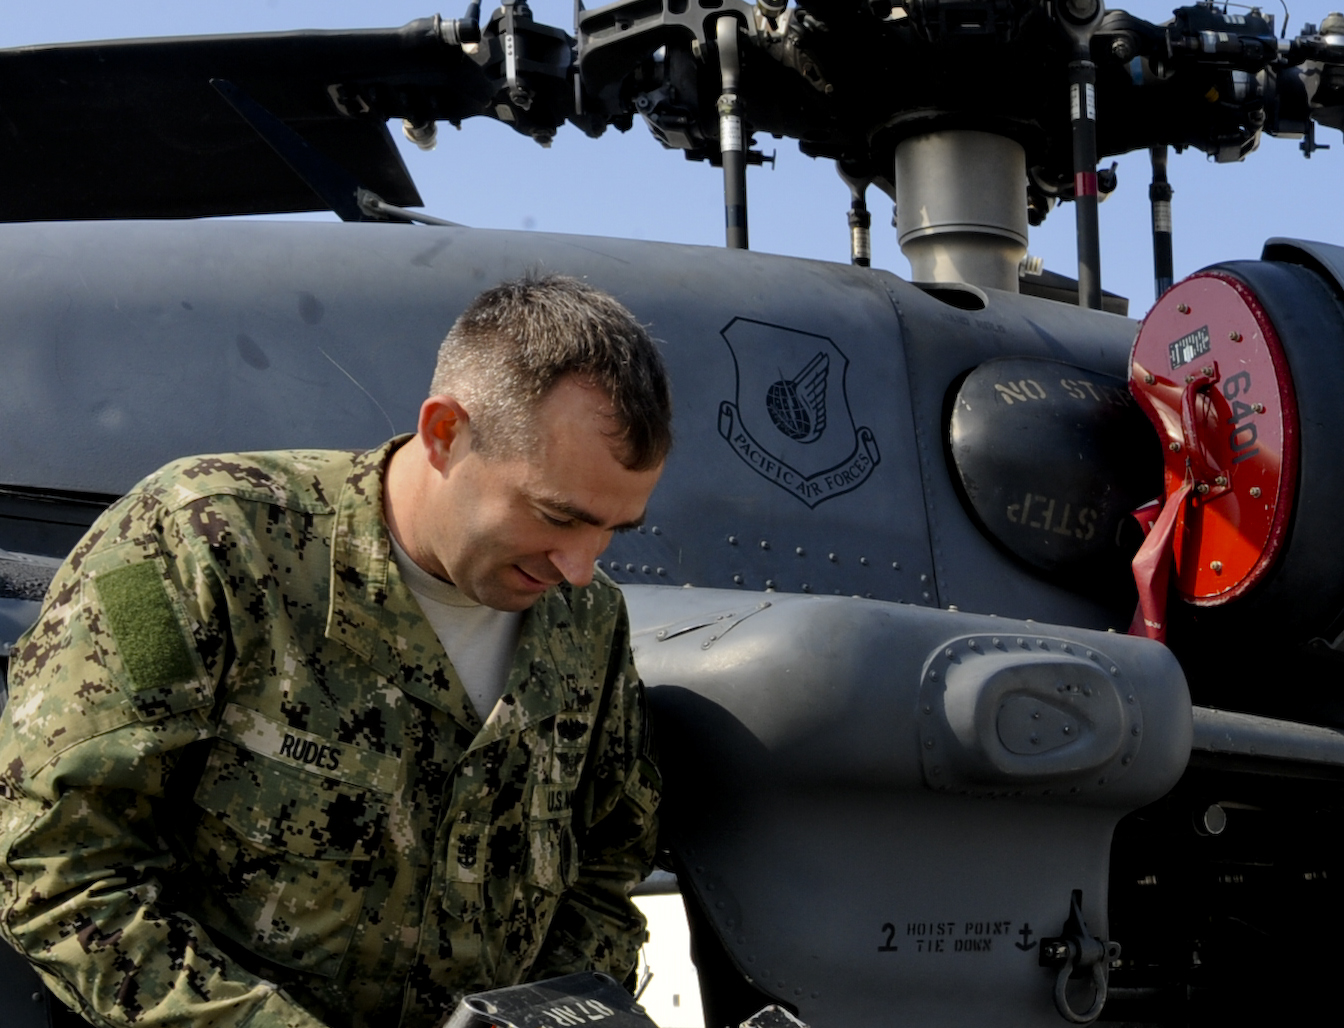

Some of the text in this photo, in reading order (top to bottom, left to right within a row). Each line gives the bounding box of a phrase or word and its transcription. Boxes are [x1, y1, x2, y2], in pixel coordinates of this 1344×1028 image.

[994, 379, 1046, 405] NO
[734, 433, 870, 498] PACIFIC AIR FORCES
[1006, 492, 1098, 540] STEP
[280, 733, 341, 770] RUDES
[877, 922, 898, 952] 2
[907, 921, 1012, 936] HOIST POINT
[916, 938, 992, 952] TIE DOWN
